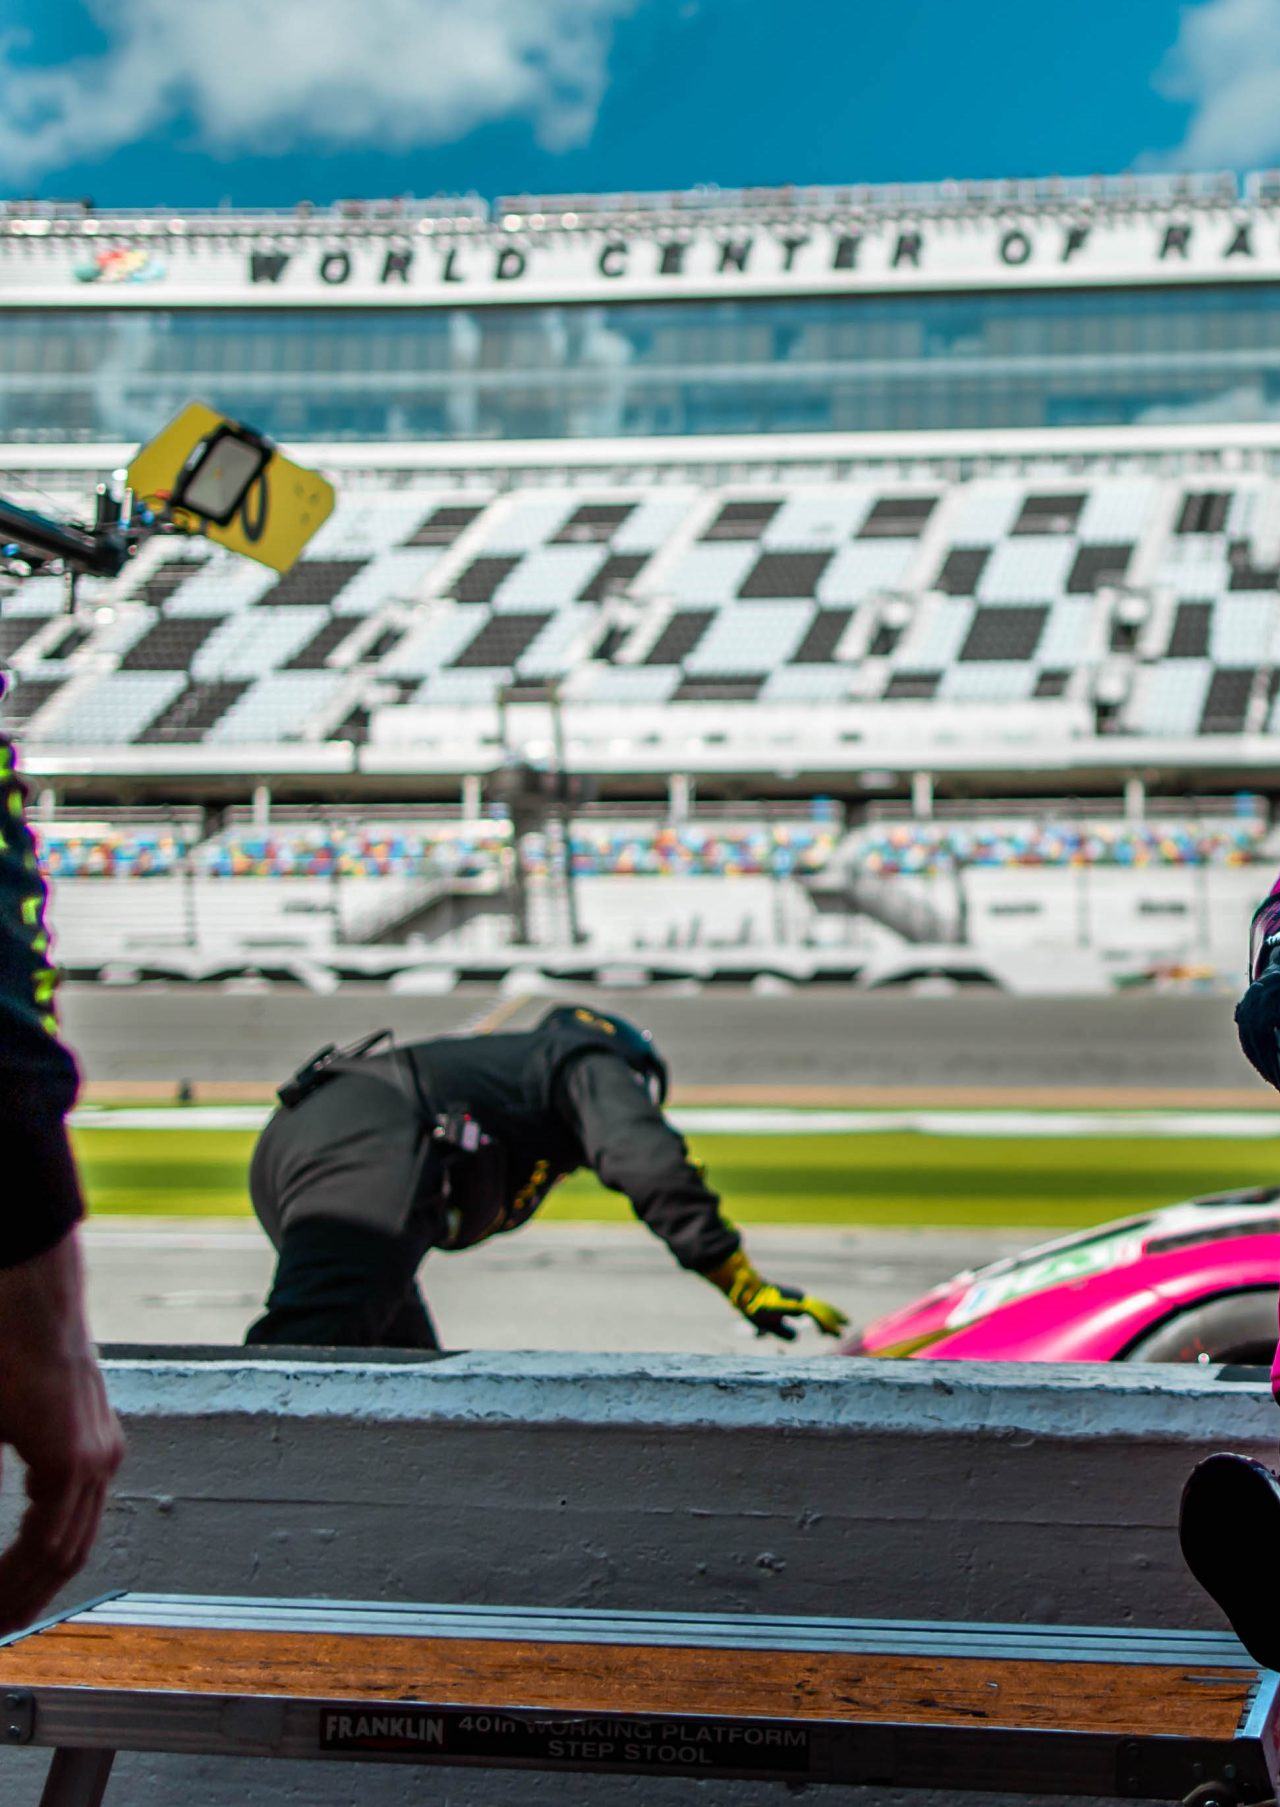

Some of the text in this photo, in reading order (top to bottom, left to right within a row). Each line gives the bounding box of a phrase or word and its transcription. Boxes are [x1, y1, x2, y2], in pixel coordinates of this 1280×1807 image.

[249, 248, 529, 285] WORLD
[600, 231, 923, 277] CENTER
[1001, 224, 1093, 266] OF
[325, 1714, 444, 1744] FRANKLIN
[662, 1723, 807, 1747] PLATFORM
[548, 1739, 713, 1764] STEP STOOL
